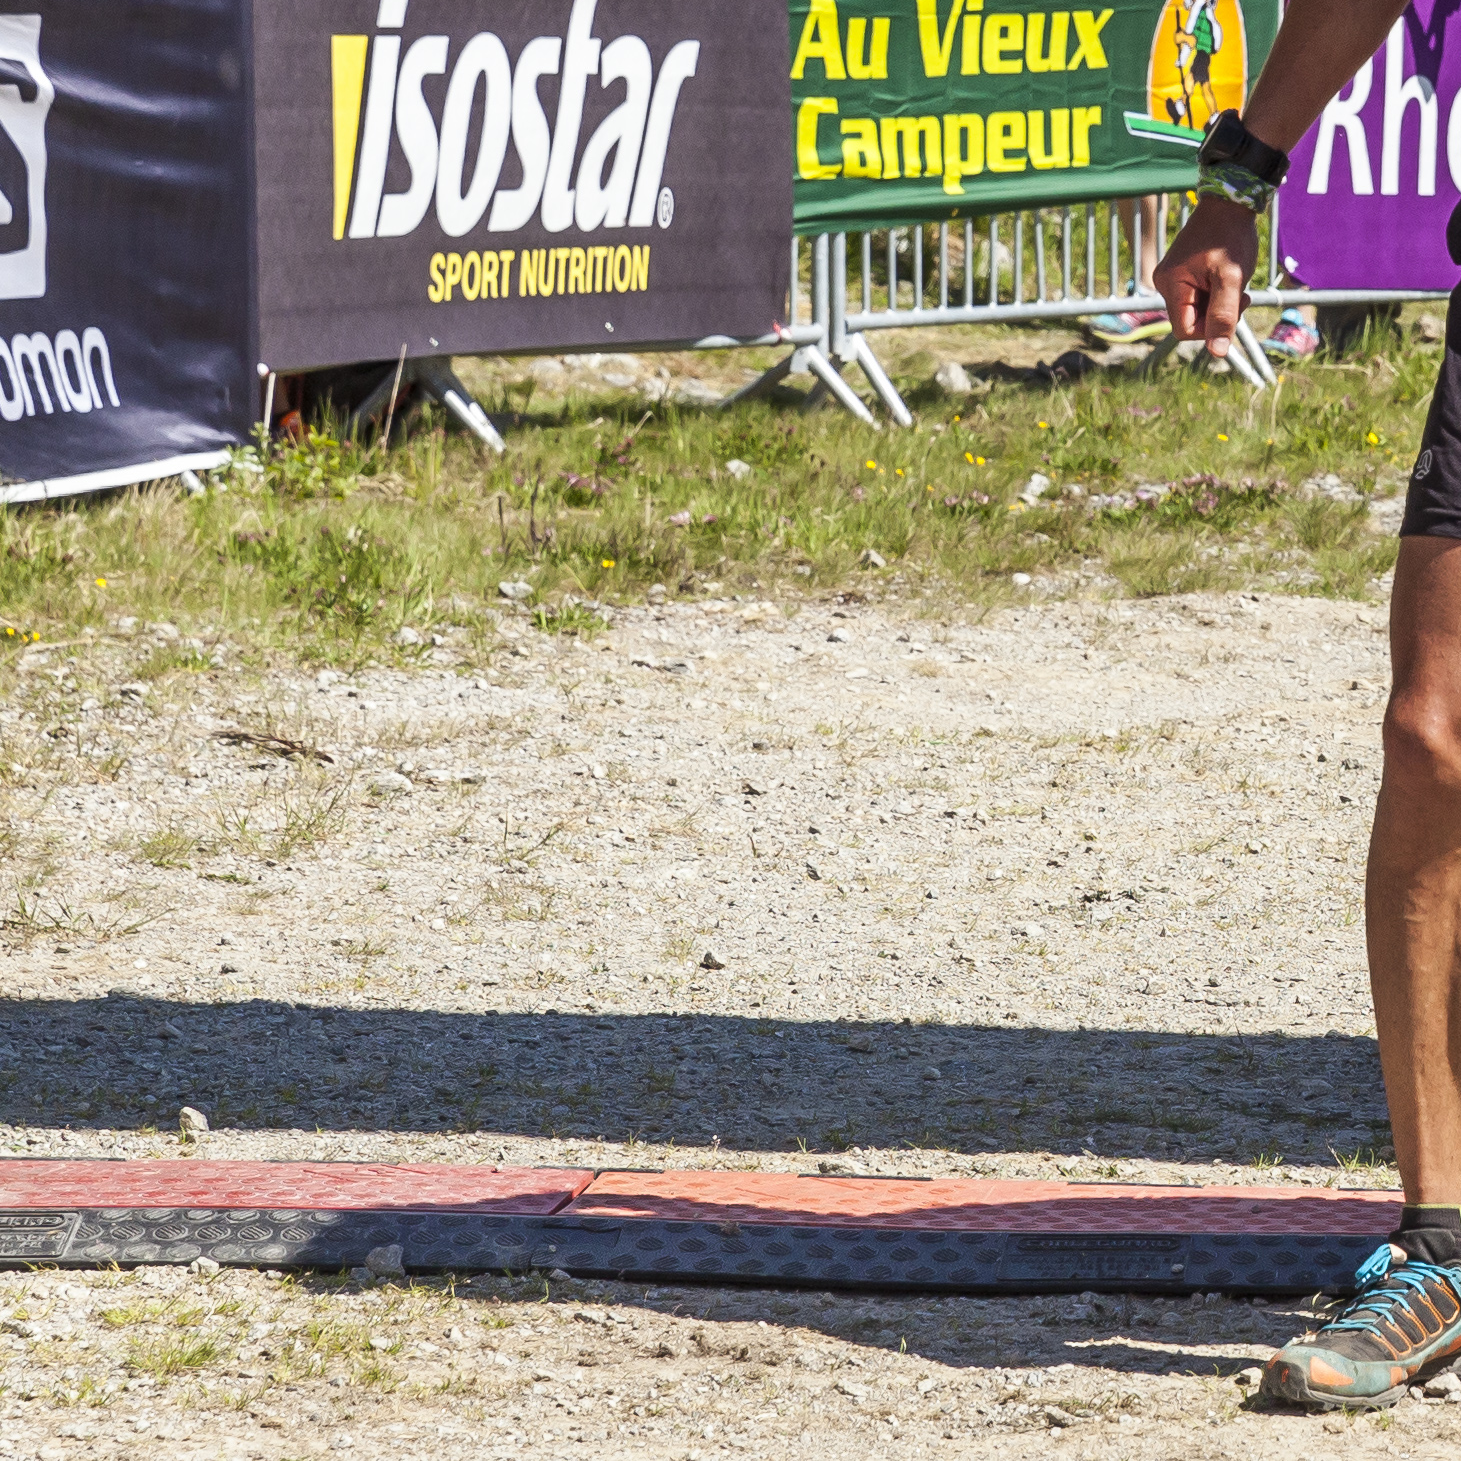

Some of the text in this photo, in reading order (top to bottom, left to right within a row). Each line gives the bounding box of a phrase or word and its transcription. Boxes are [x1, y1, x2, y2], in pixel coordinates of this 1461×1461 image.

[797, 96, 1102, 195] Campeur
[427, 243, 650, 303] SPORT NUTRITION
